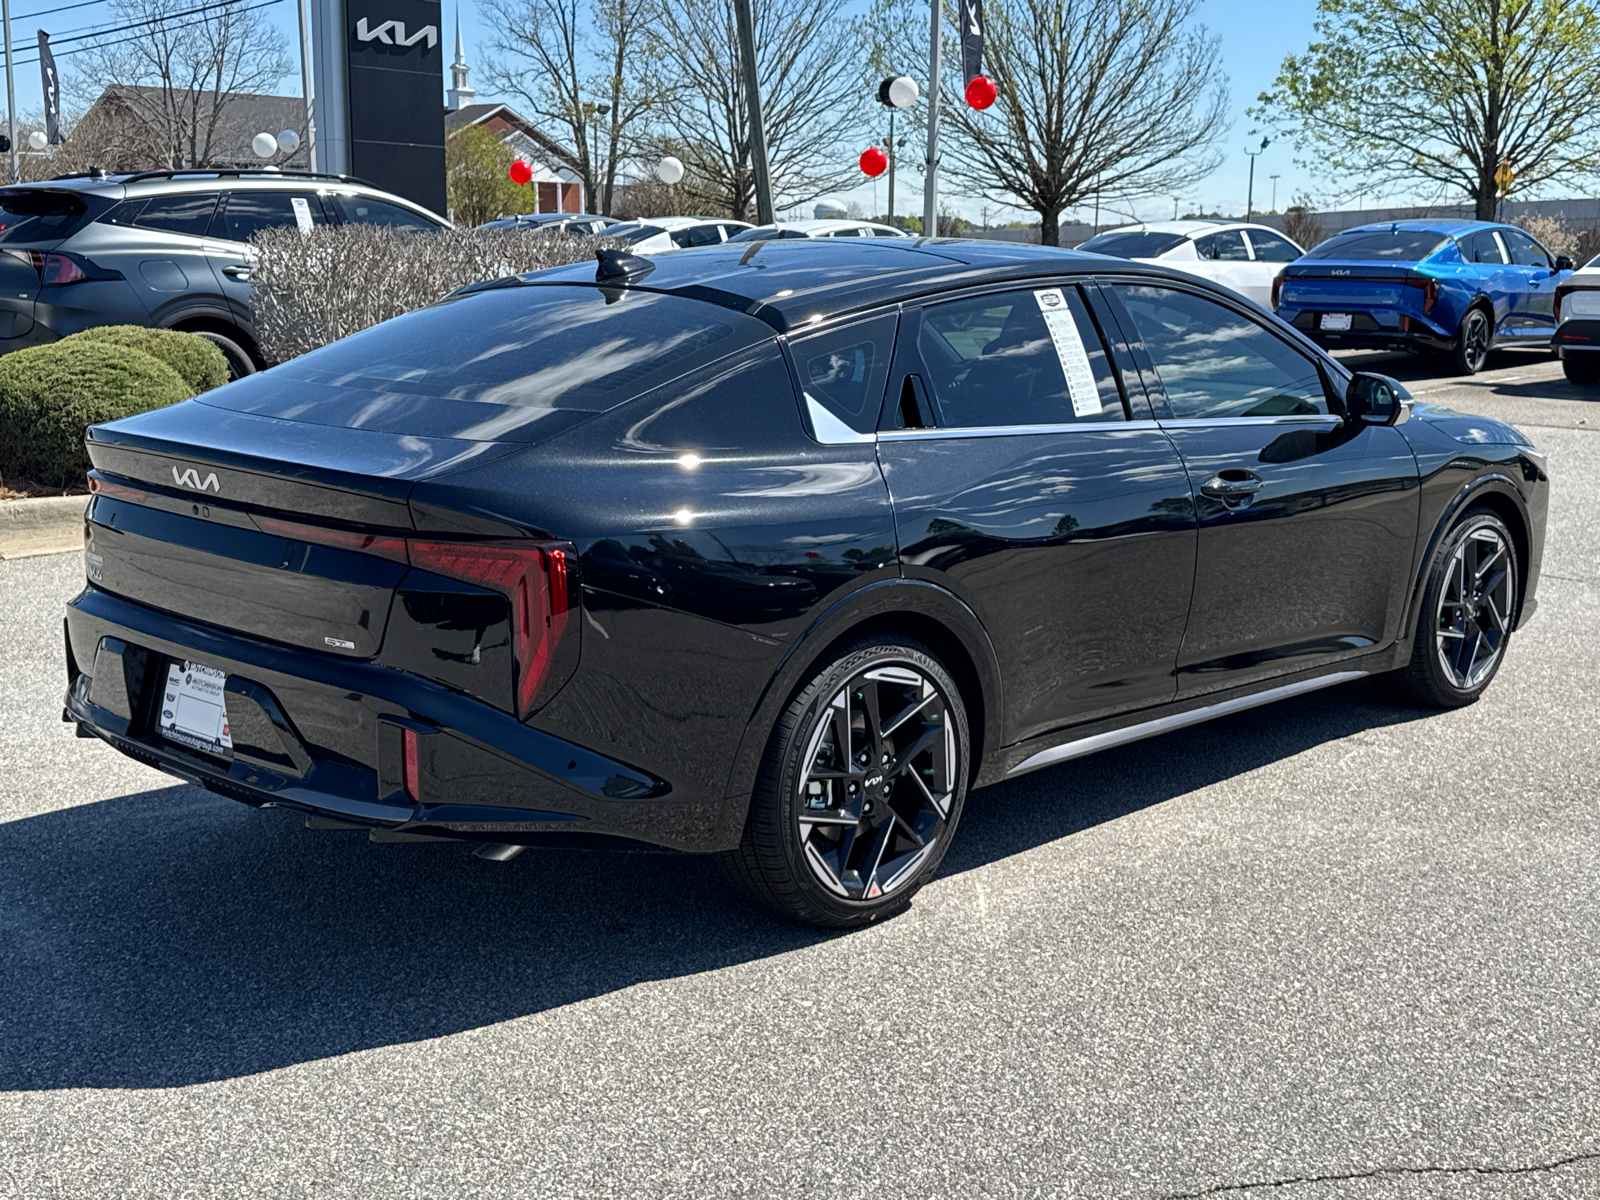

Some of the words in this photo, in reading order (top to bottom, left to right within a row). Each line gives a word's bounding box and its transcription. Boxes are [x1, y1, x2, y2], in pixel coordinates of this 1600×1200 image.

[356, 16, 437, 49] KIA
[172, 465, 220, 493] KIA
[912, 651, 953, 691] KUMHO
